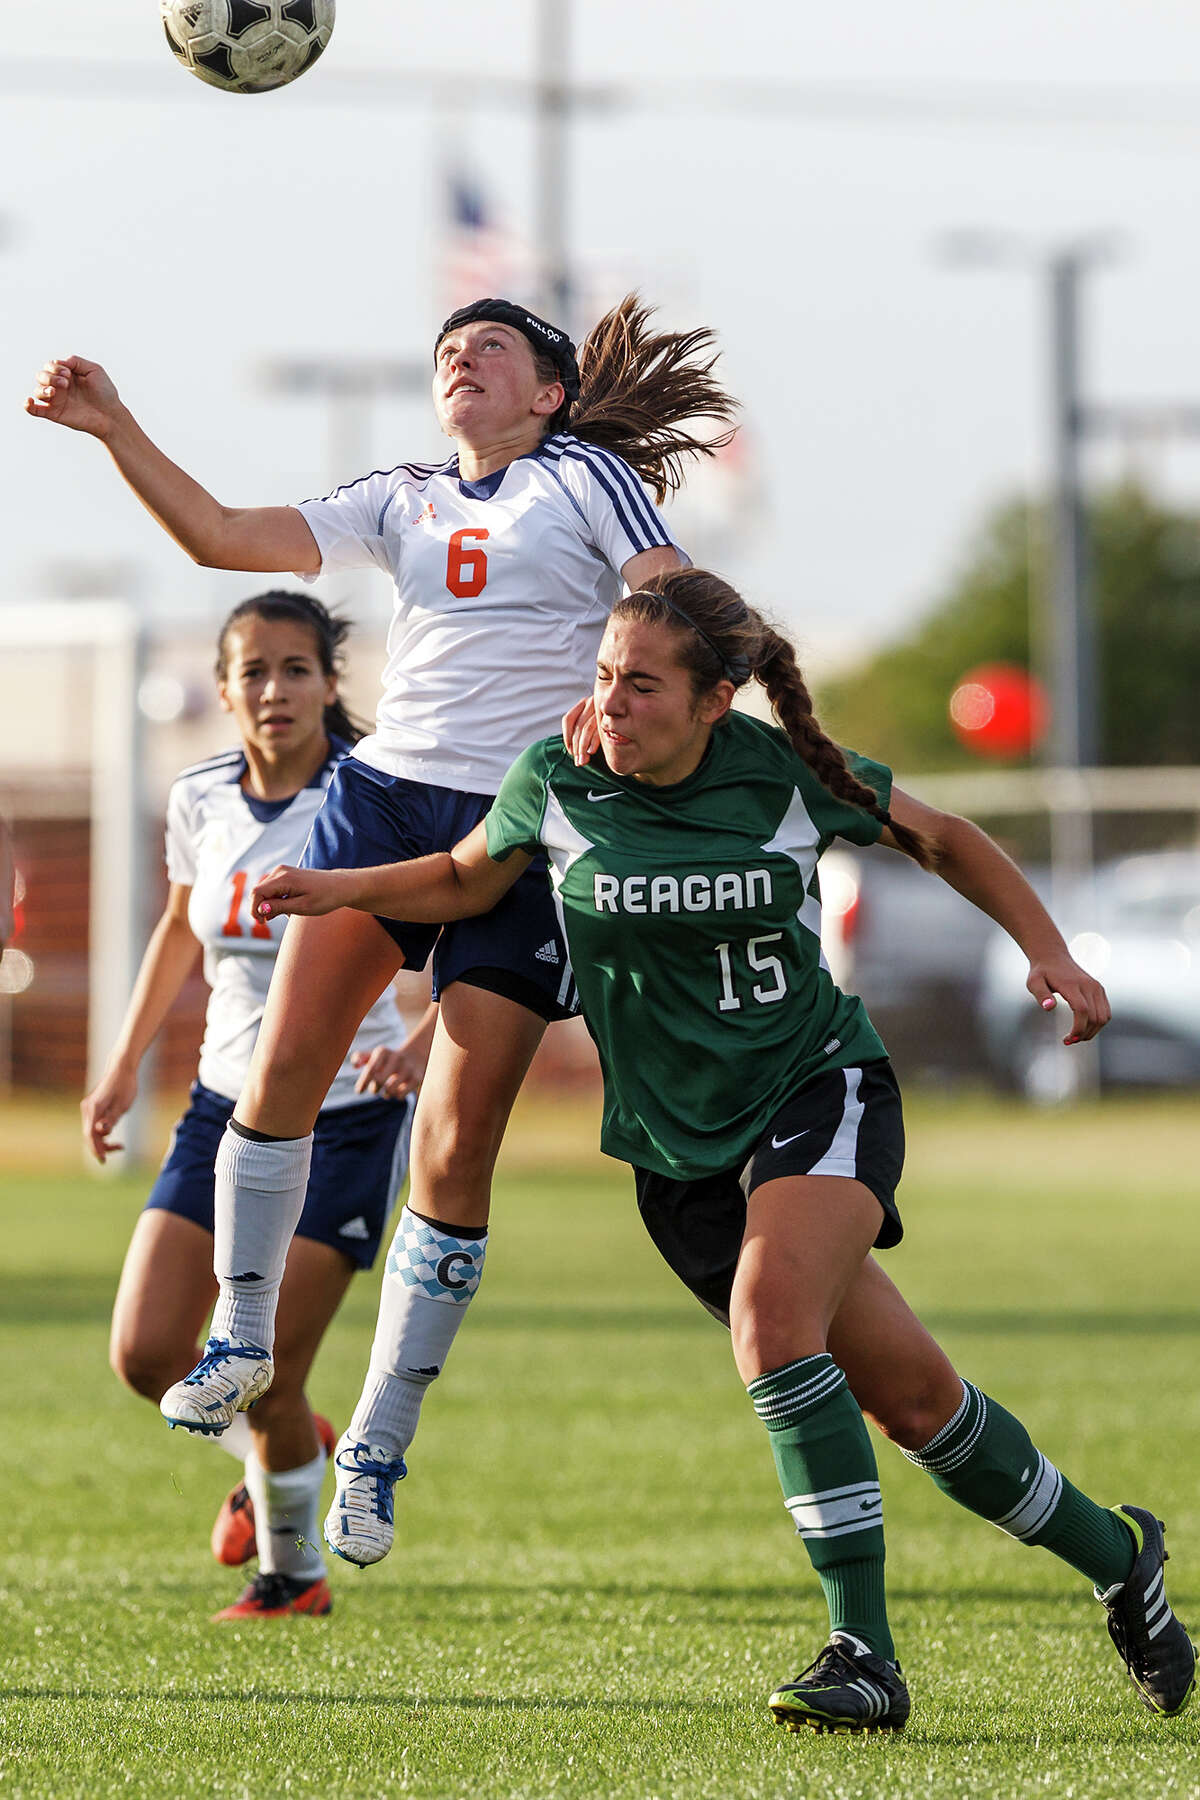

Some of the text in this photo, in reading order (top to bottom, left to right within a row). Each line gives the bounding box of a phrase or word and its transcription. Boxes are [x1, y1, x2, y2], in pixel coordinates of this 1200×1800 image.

[446, 528, 490, 598] 6
[593, 868, 773, 914] REAGAN
[534, 951, 559, 964] adidas
[714, 931, 788, 1011] 15
[436, 1250, 474, 1290] C
